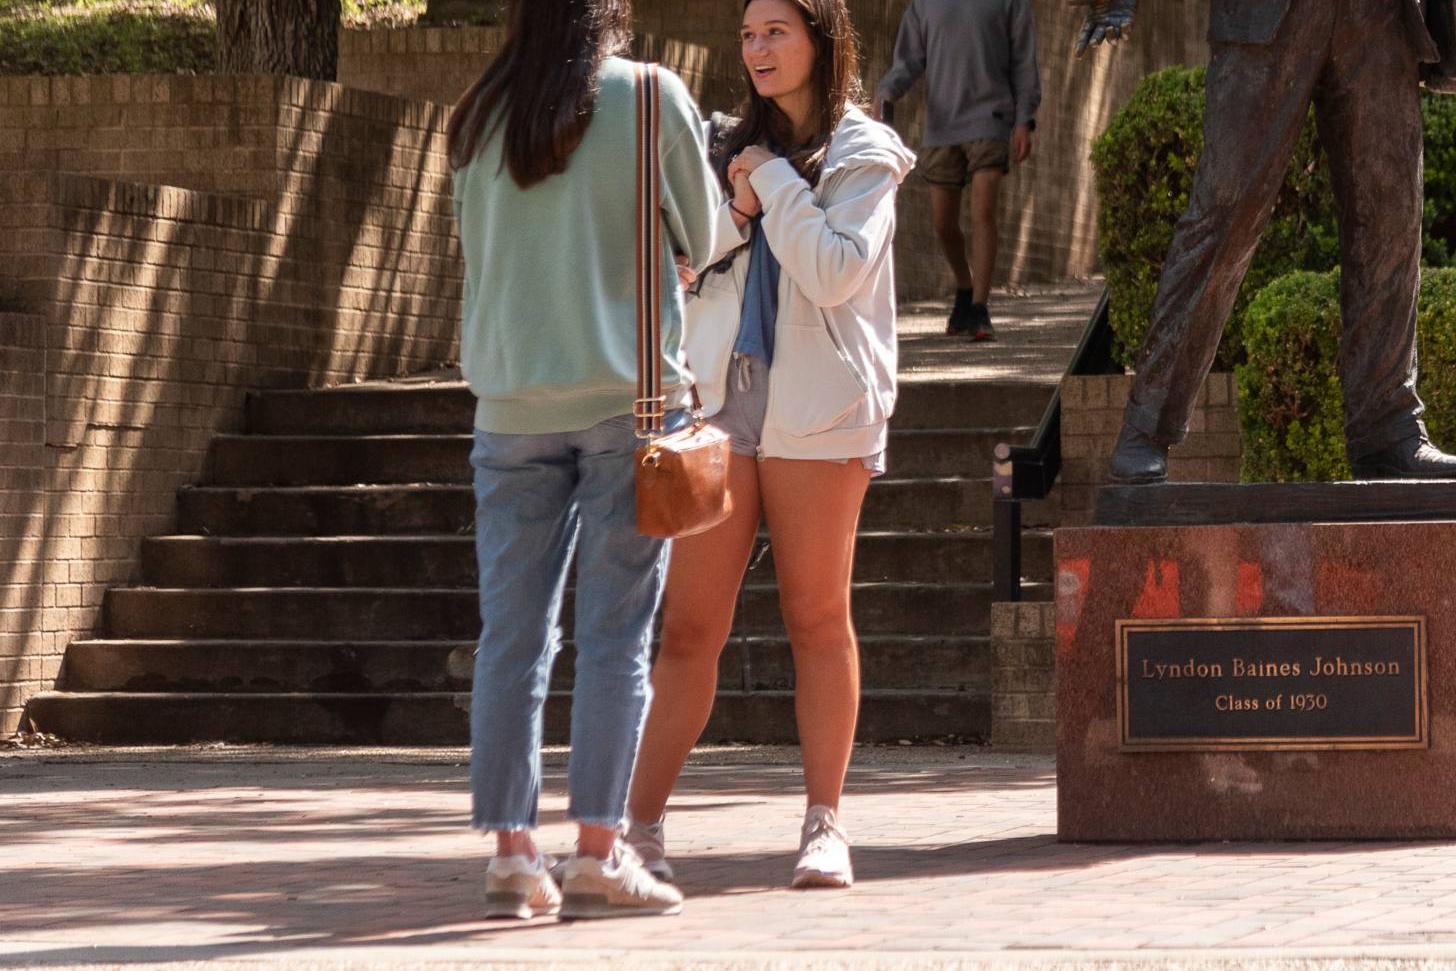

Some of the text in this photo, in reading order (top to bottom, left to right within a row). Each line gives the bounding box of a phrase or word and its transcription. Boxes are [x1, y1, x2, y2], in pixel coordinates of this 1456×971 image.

[1142, 656, 1400, 681] Lyndon Baines Johnson
[1215, 694, 1328, 712] Class of 1930
